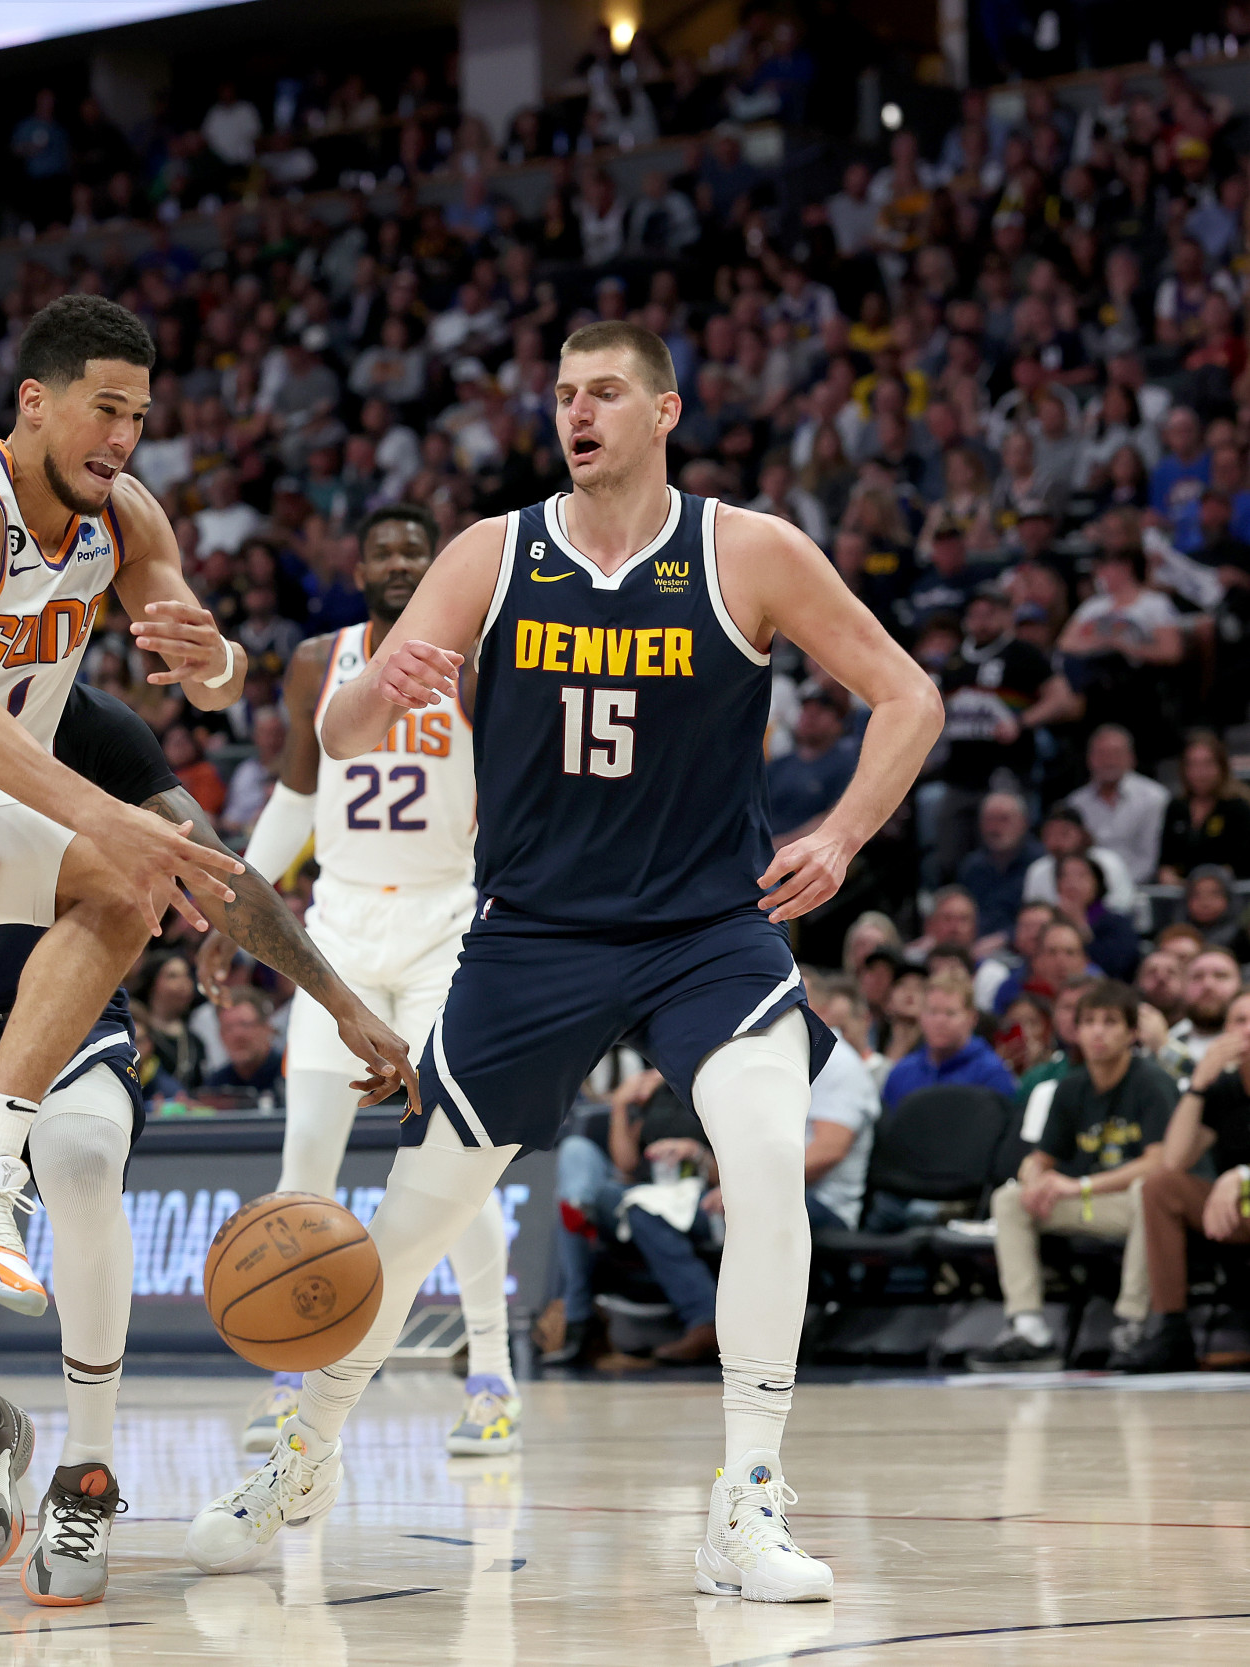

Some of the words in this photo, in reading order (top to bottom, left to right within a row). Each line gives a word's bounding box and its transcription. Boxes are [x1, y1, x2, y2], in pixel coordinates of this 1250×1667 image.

[8, 529, 20, 553] 6
[530, 541, 546, 561] 6
[77, 544, 111, 562] PayPal
[654, 561, 689, 577] WU
[654, 578, 689, 586] Western
[515, 619, 694, 676] DENVER
[559, 685, 638, 779] 15
[345, 765, 427, 831] 22
